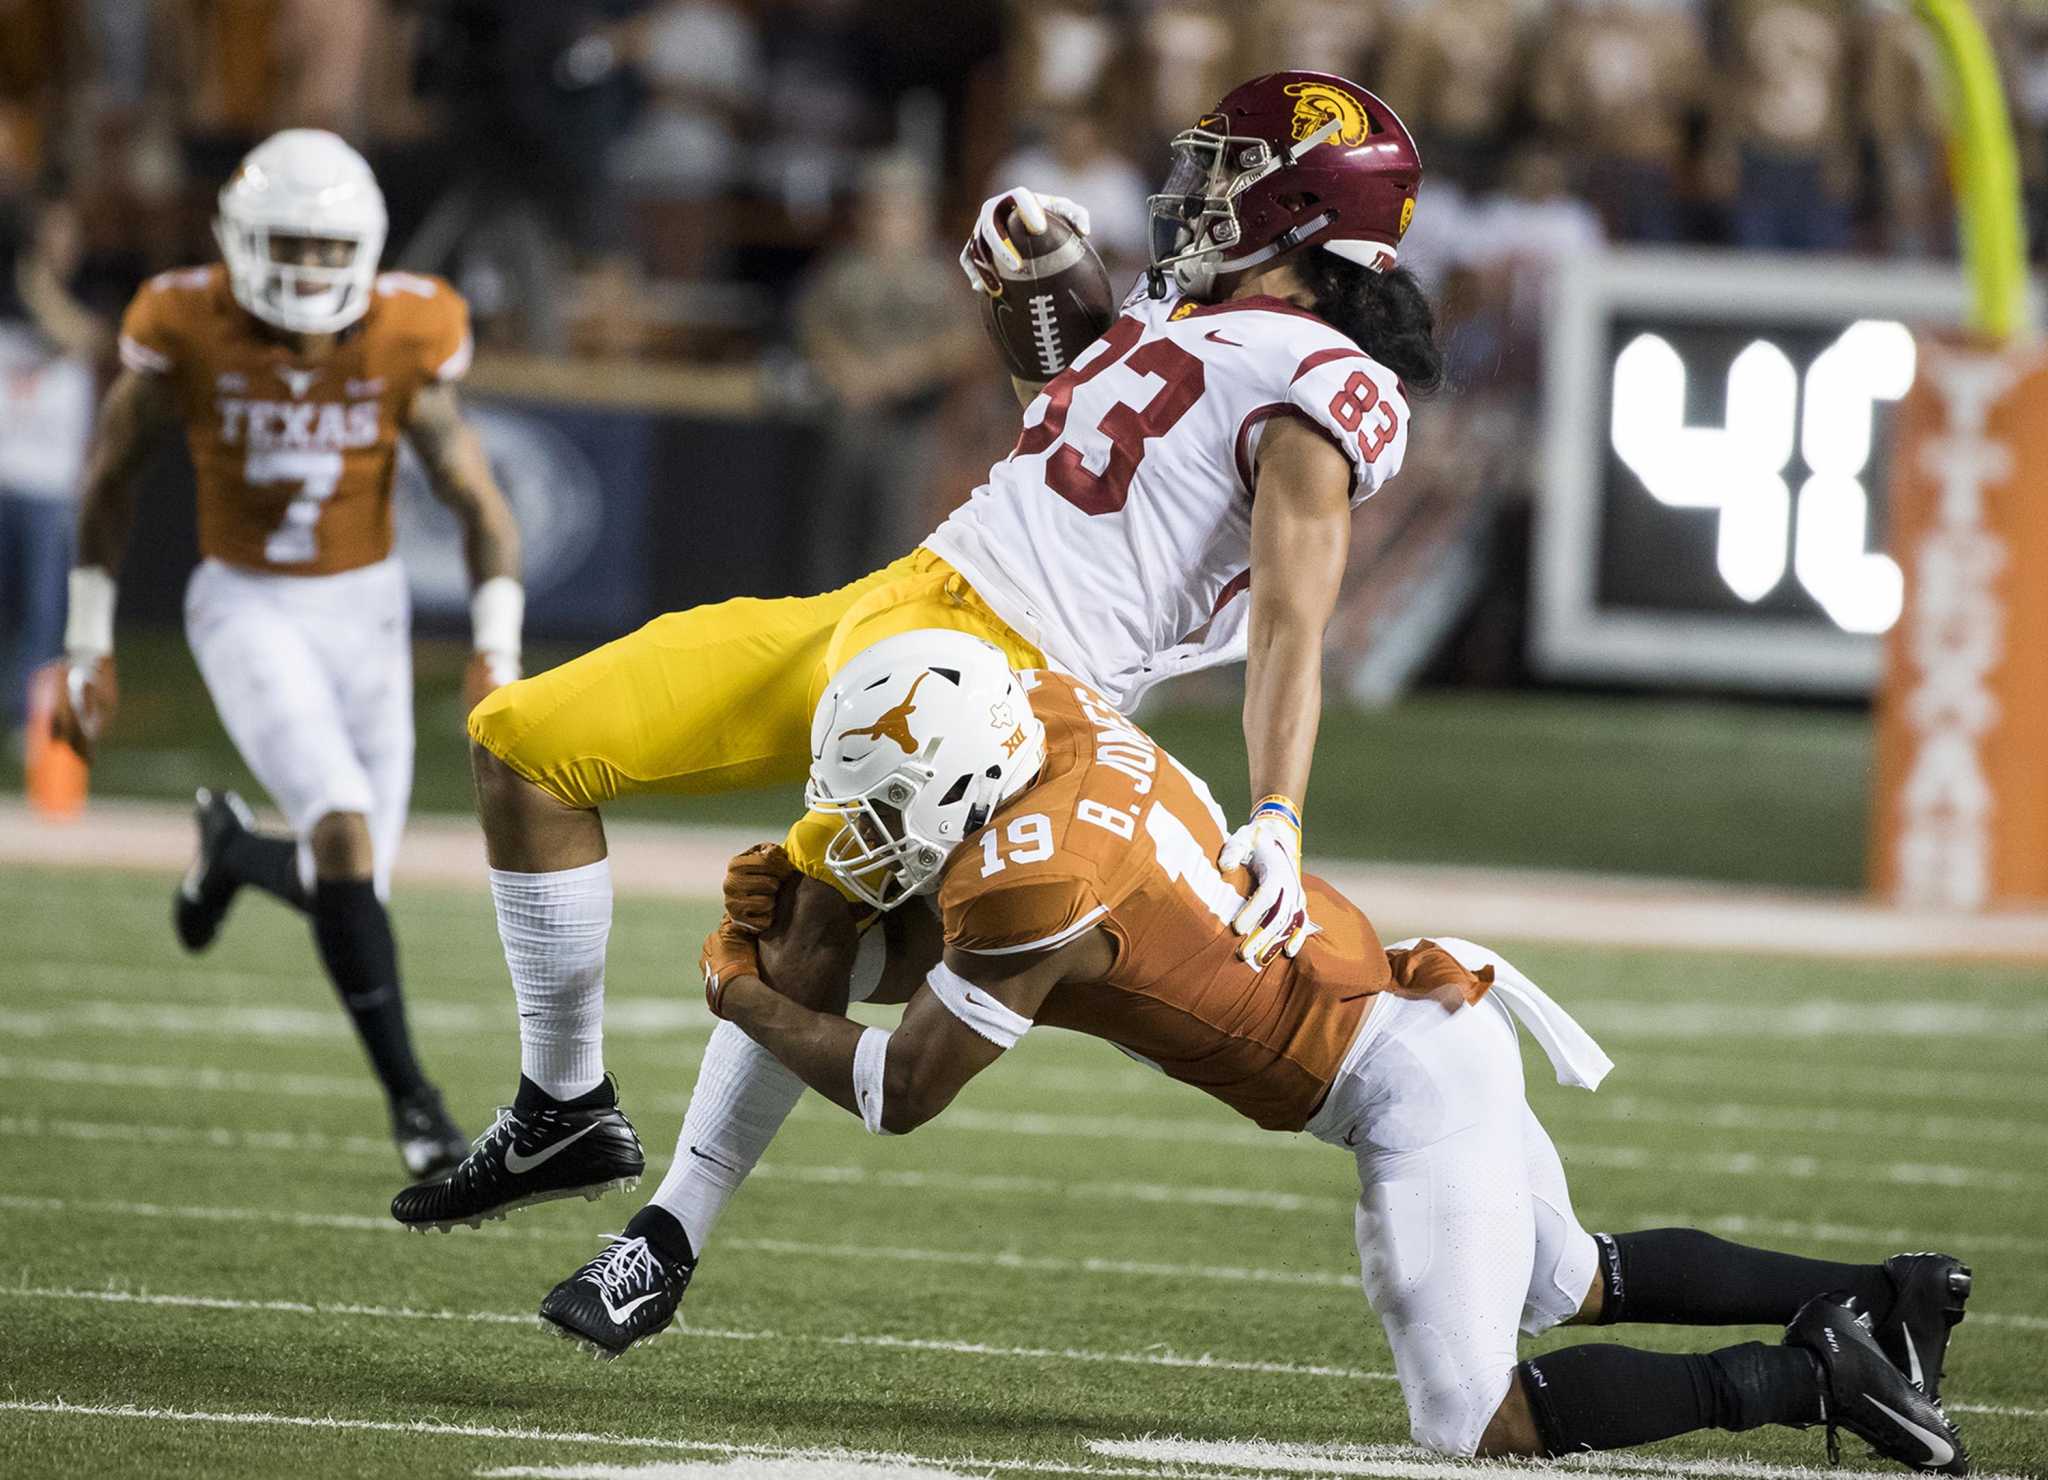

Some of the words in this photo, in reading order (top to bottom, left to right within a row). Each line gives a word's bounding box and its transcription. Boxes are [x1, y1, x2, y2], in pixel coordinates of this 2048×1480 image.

[215, 401, 380, 451] TEXAS
[1013, 315, 1206, 516] 83
[1329, 371, 1398, 463] 83
[245, 452, 343, 563] 7
[979, 813, 1054, 878] 19
[1076, 799, 1142, 842] B.
